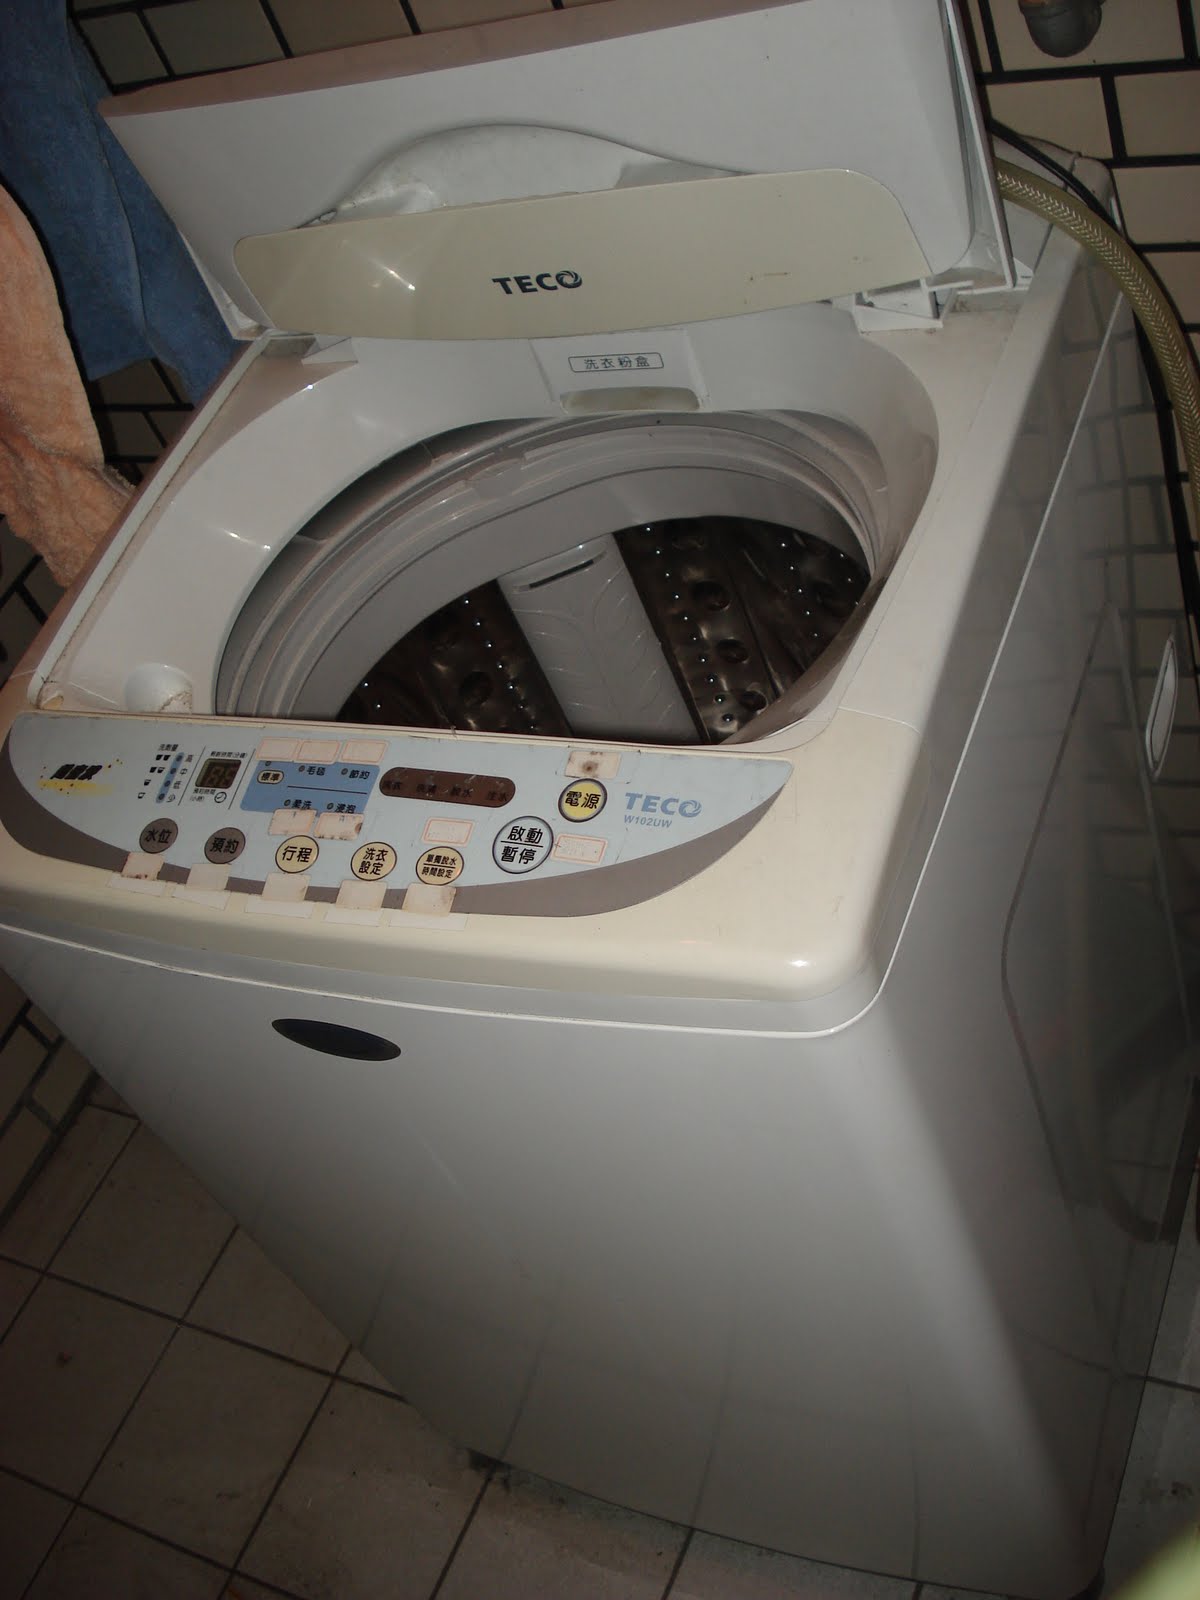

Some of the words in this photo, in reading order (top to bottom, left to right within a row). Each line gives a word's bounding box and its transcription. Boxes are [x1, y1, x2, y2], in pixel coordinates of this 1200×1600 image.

[492, 270, 582, 295] TECO
[583, 355, 651, 371] 洗衣粉盒
[179, 768, 188, 776] 中
[260, 772, 281, 782] 標準
[306, 766, 326, 776] 毛毯
[348, 769, 370, 780] 節約
[334, 803, 356, 814] 浸泡
[564, 791, 602, 810] 電源
[624, 792, 703, 818] TECO
[624, 814, 673, 829] W102UW
[143, 827, 173, 844] 水位
[507, 825, 543, 844] 啟動
[208, 836, 240, 854] 預約
[281, 845, 313, 863] 行程
[363, 847, 389, 863] 洗衣
[501, 845, 537, 864] 暫停
[358, 861, 384, 876] 設定
[421, 866, 454, 879] 時間設定
